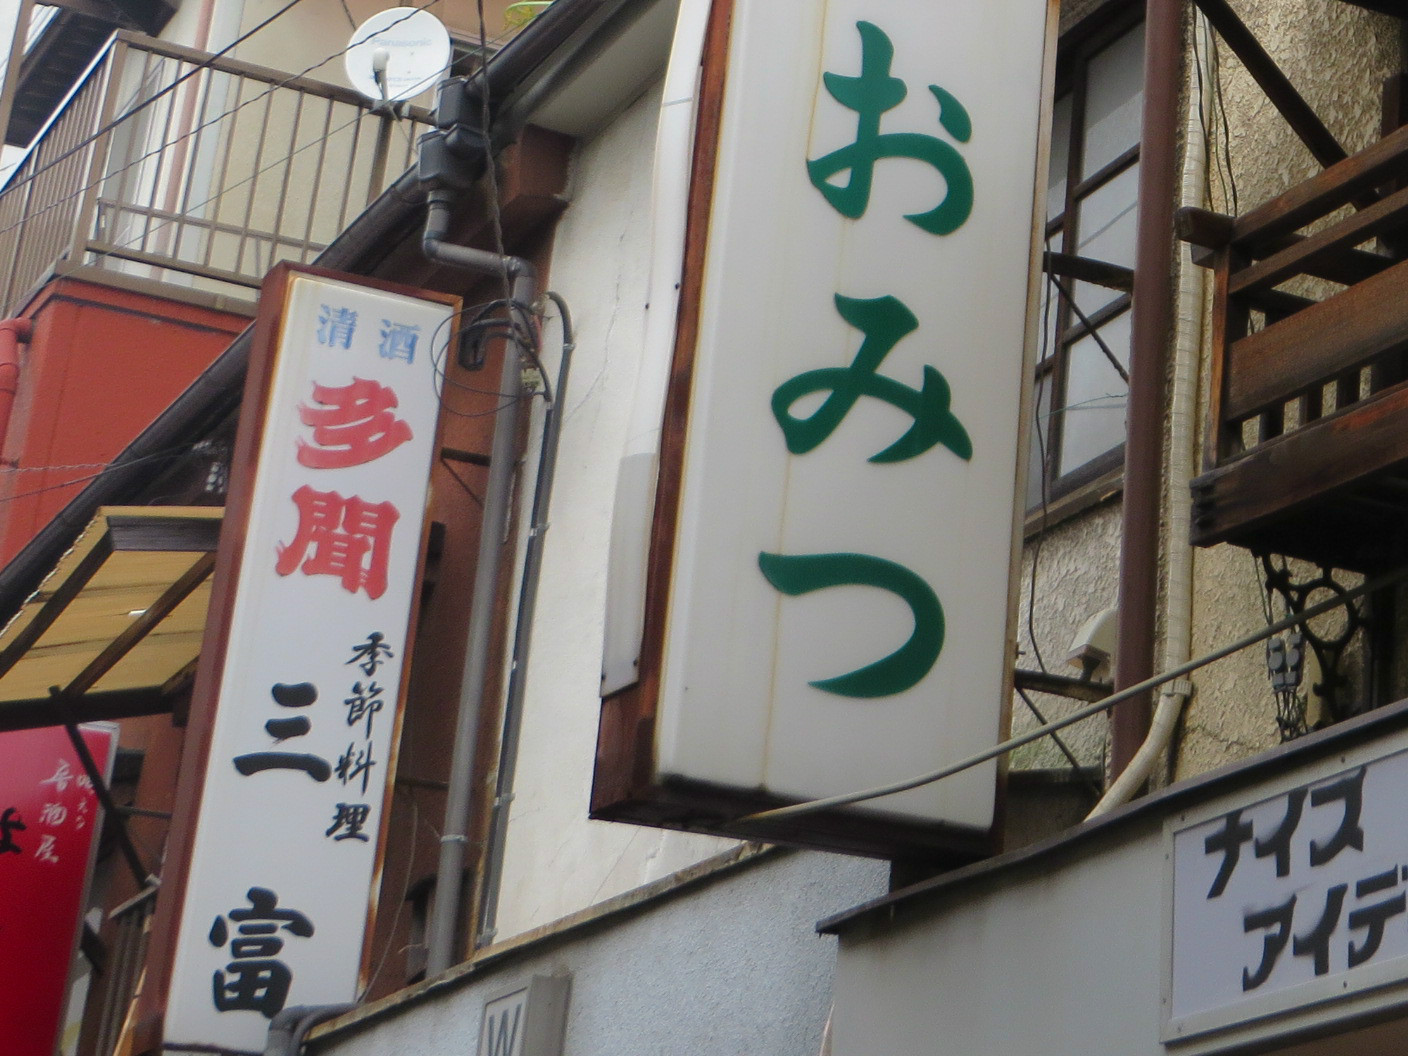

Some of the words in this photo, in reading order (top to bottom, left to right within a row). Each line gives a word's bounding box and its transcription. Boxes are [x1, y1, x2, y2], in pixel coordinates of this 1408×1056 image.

[757, 19, 974, 699] おみつ
[209, 681, 333, 1019] 三富
[325, 631, 395, 843] 季節料理
